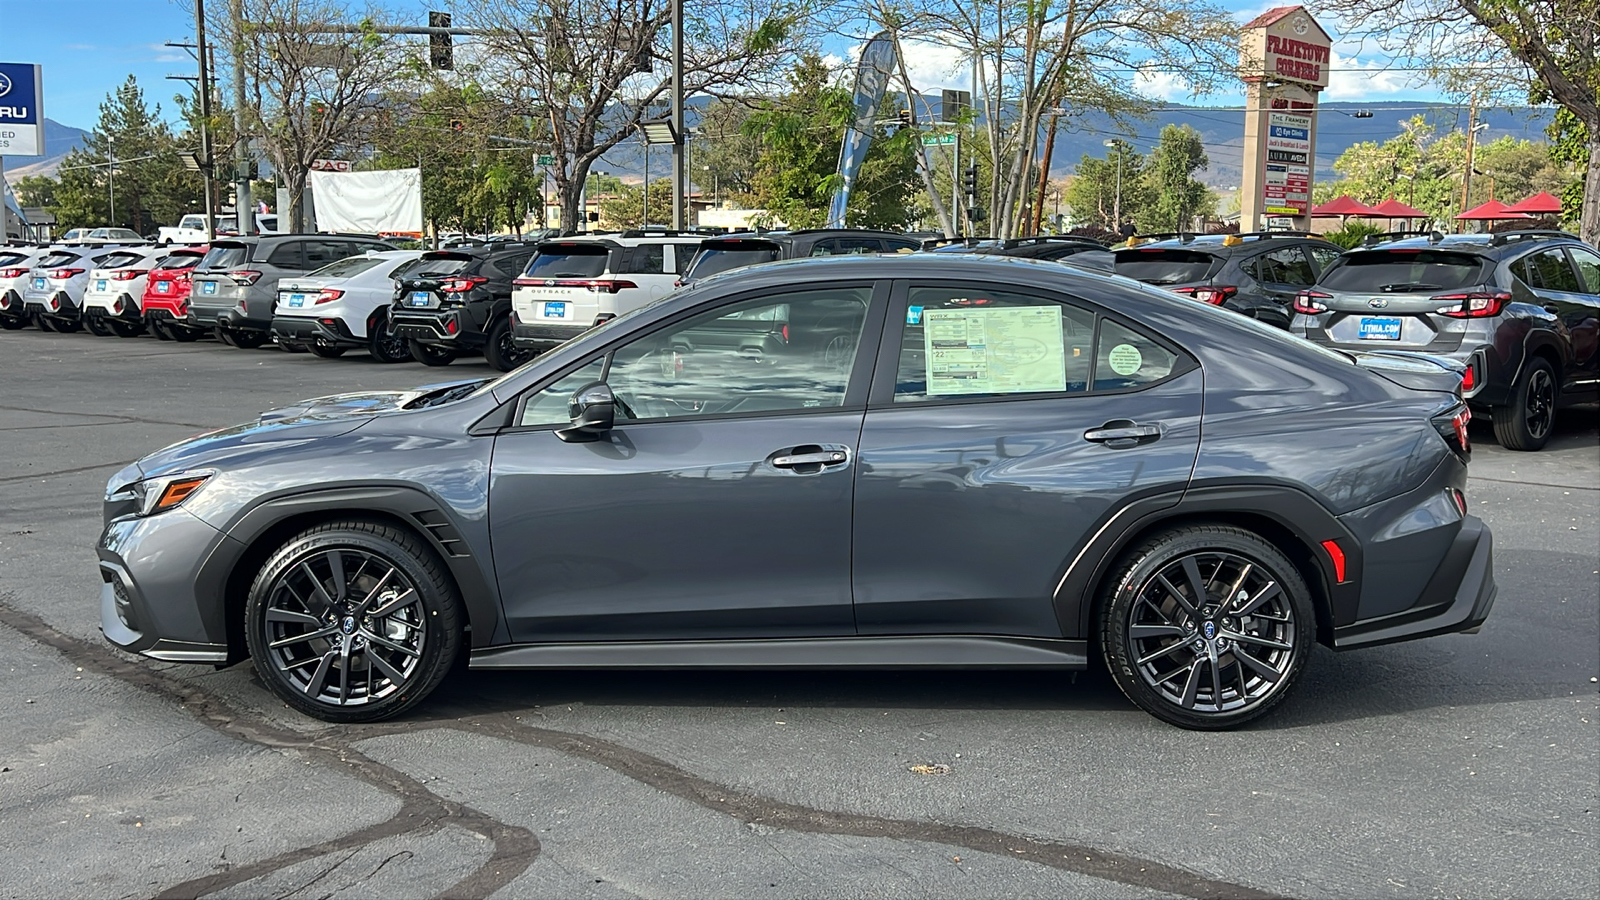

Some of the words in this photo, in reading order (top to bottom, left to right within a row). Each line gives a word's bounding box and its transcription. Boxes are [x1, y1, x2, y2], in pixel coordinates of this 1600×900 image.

[1266, 35, 1330, 64] FRANKTOWN
[1276, 57, 1320, 82] CORNERS
[1272, 114, 1283, 122] THE
[1285, 115, 1309, 124] FRAMERY
[1282, 128, 1291, 137] Eye
[1291, 129, 1303, 137] Clinic
[1269, 151, 1288, 160] AURA
[1290, 154, 1306, 162] AVEDA
[1360, 324, 1400, 333] LITHIA.COM
[267, 538, 322, 580] DUNLOP
[1114, 609, 1133, 676] DUNLOP
